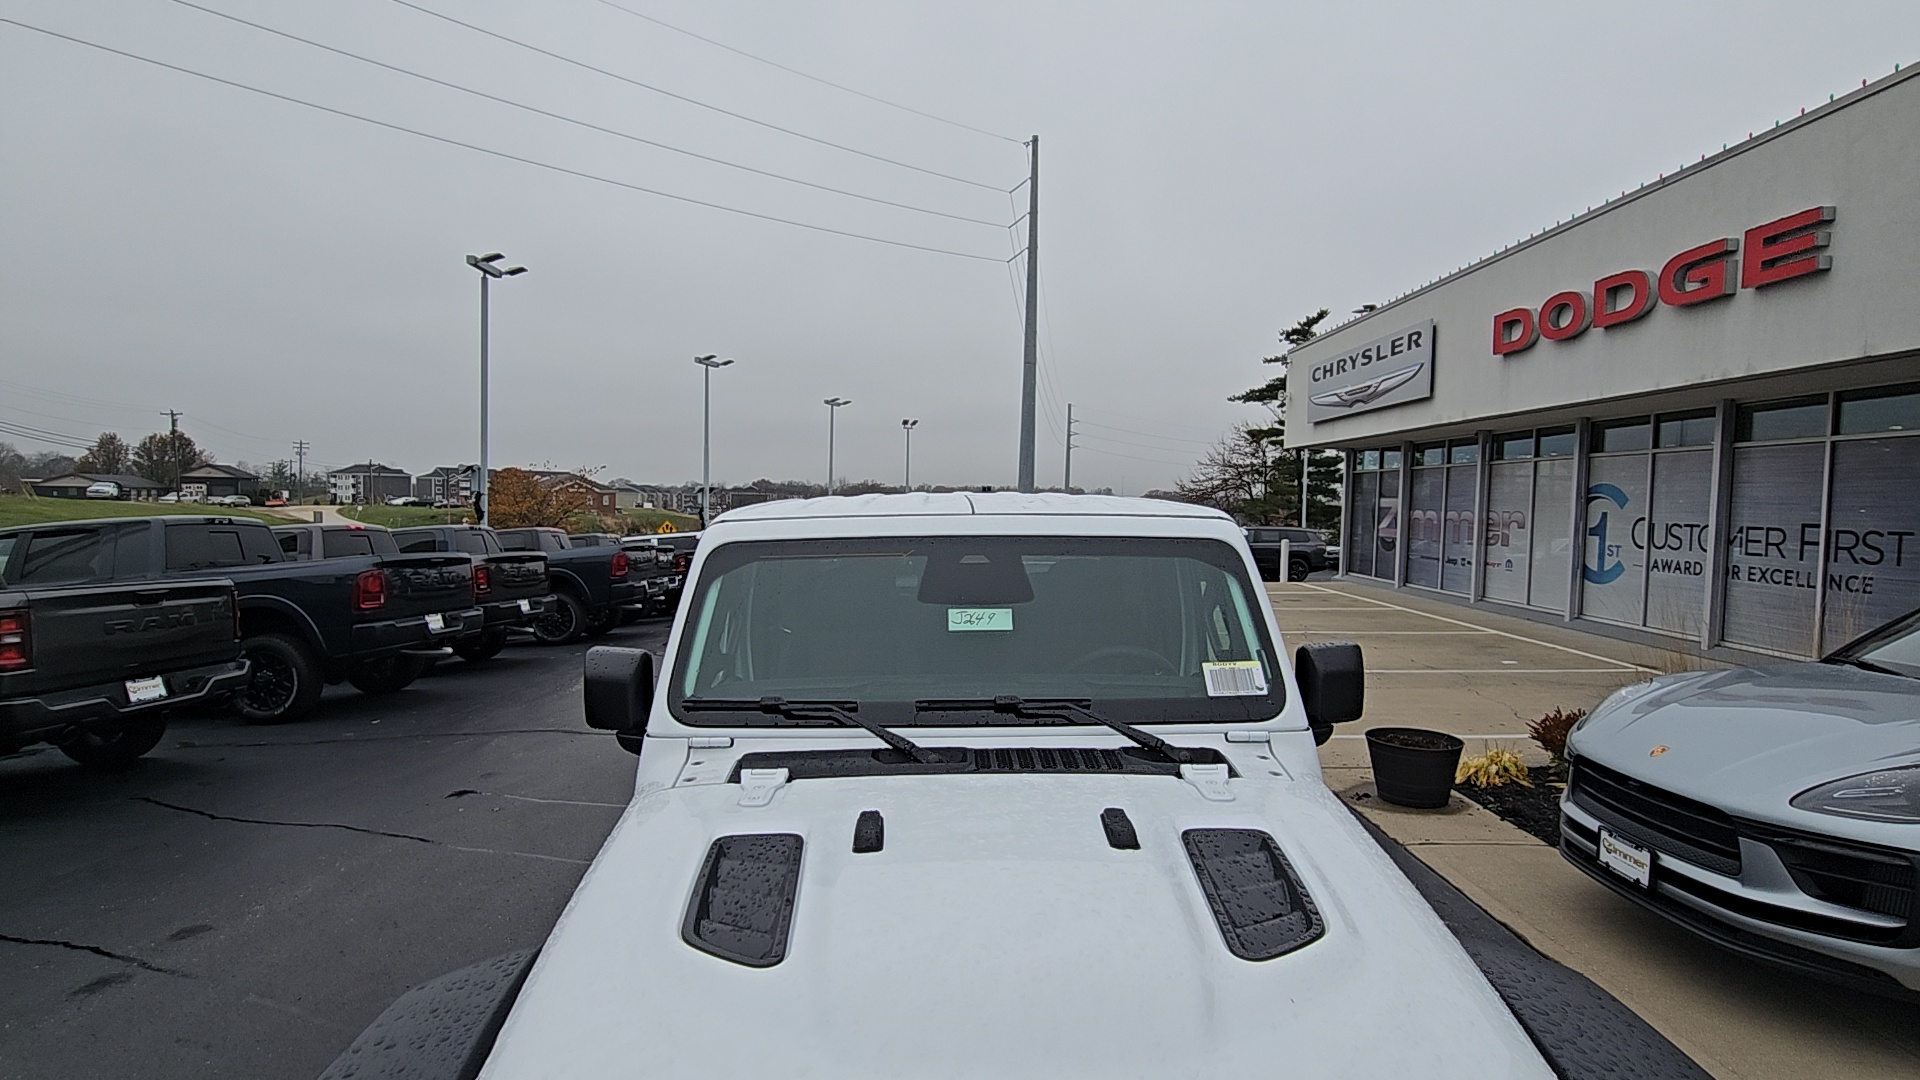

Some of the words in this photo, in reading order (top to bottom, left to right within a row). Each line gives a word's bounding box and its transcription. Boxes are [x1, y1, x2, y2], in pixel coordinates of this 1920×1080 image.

[1493, 206, 1836, 356] DODGE
[1311, 330, 1423, 383] CHRYSLER
[1377, 498, 1526, 548] Zmmer
[1651, 558, 1704, 577] AWARD
[1747, 565, 1875, 595] EXCELLNCE
